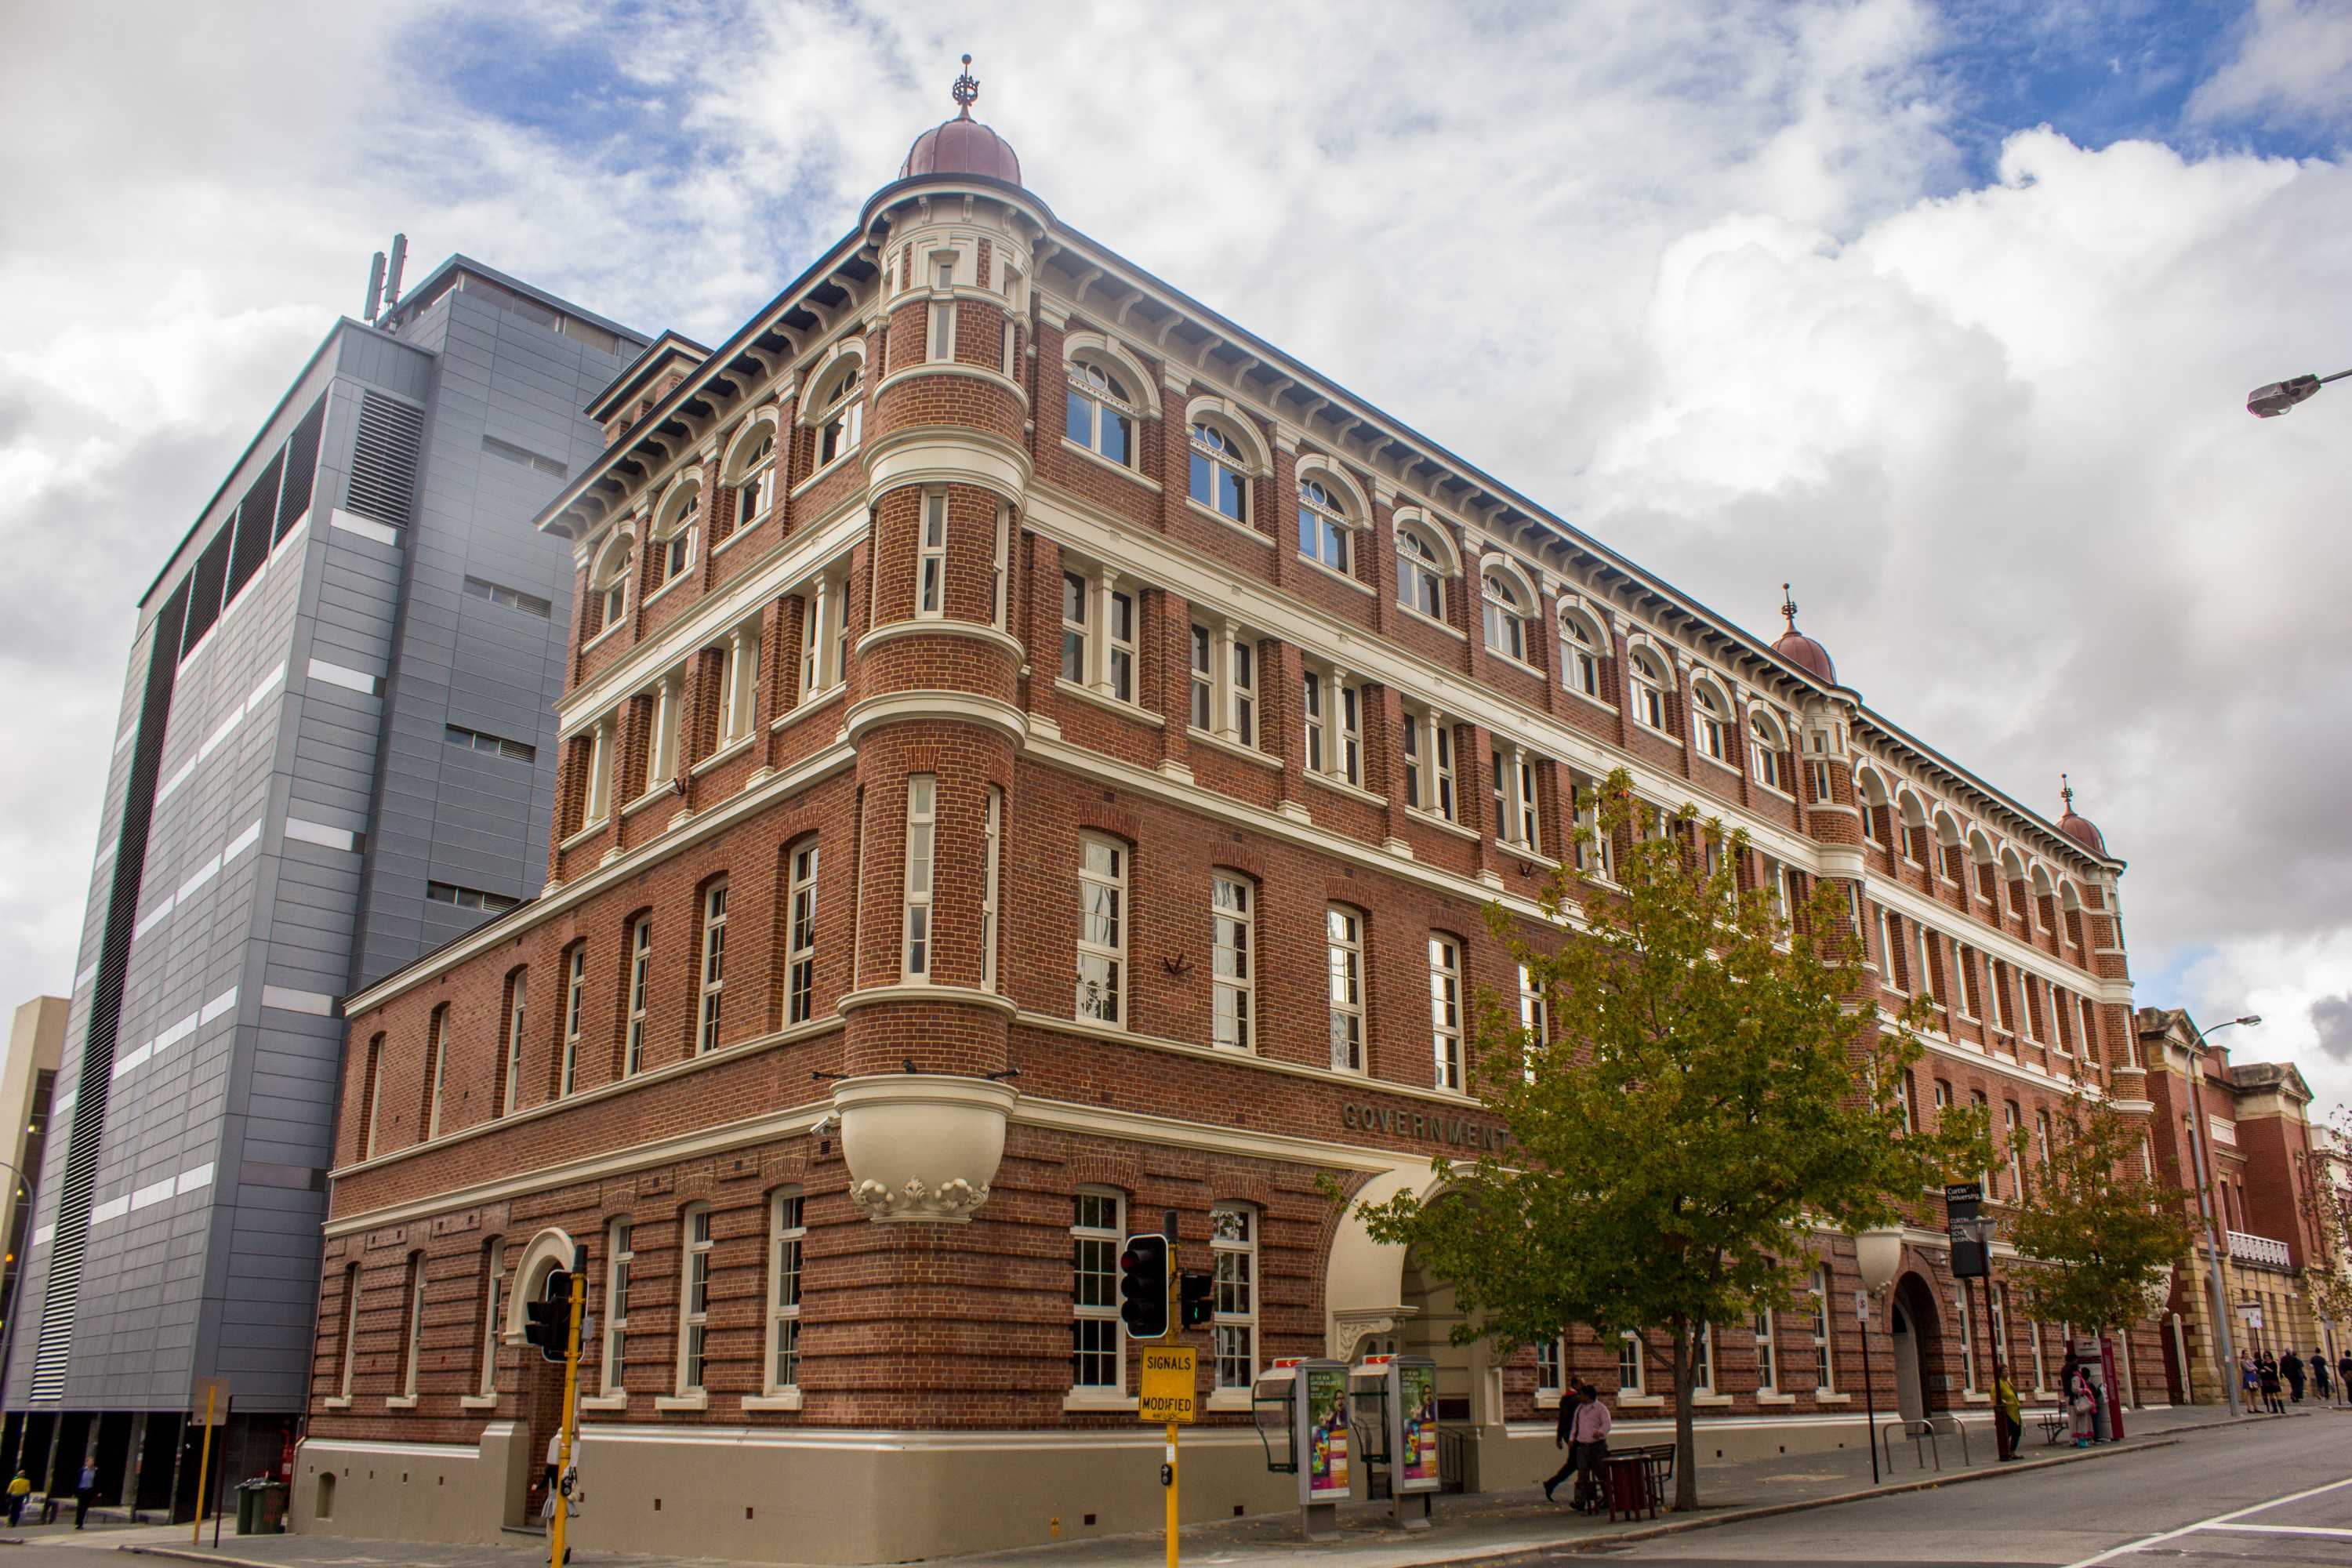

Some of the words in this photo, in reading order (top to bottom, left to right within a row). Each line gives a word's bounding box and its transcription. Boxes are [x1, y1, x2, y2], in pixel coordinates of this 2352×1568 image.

[1342, 1102, 1508, 1149] GOVERNMENT
[1947, 1193, 1980, 1202] University
[1147, 1356, 1191, 1370] SIGNALS
[1142, 1397, 1192, 1412] MODIFIED
